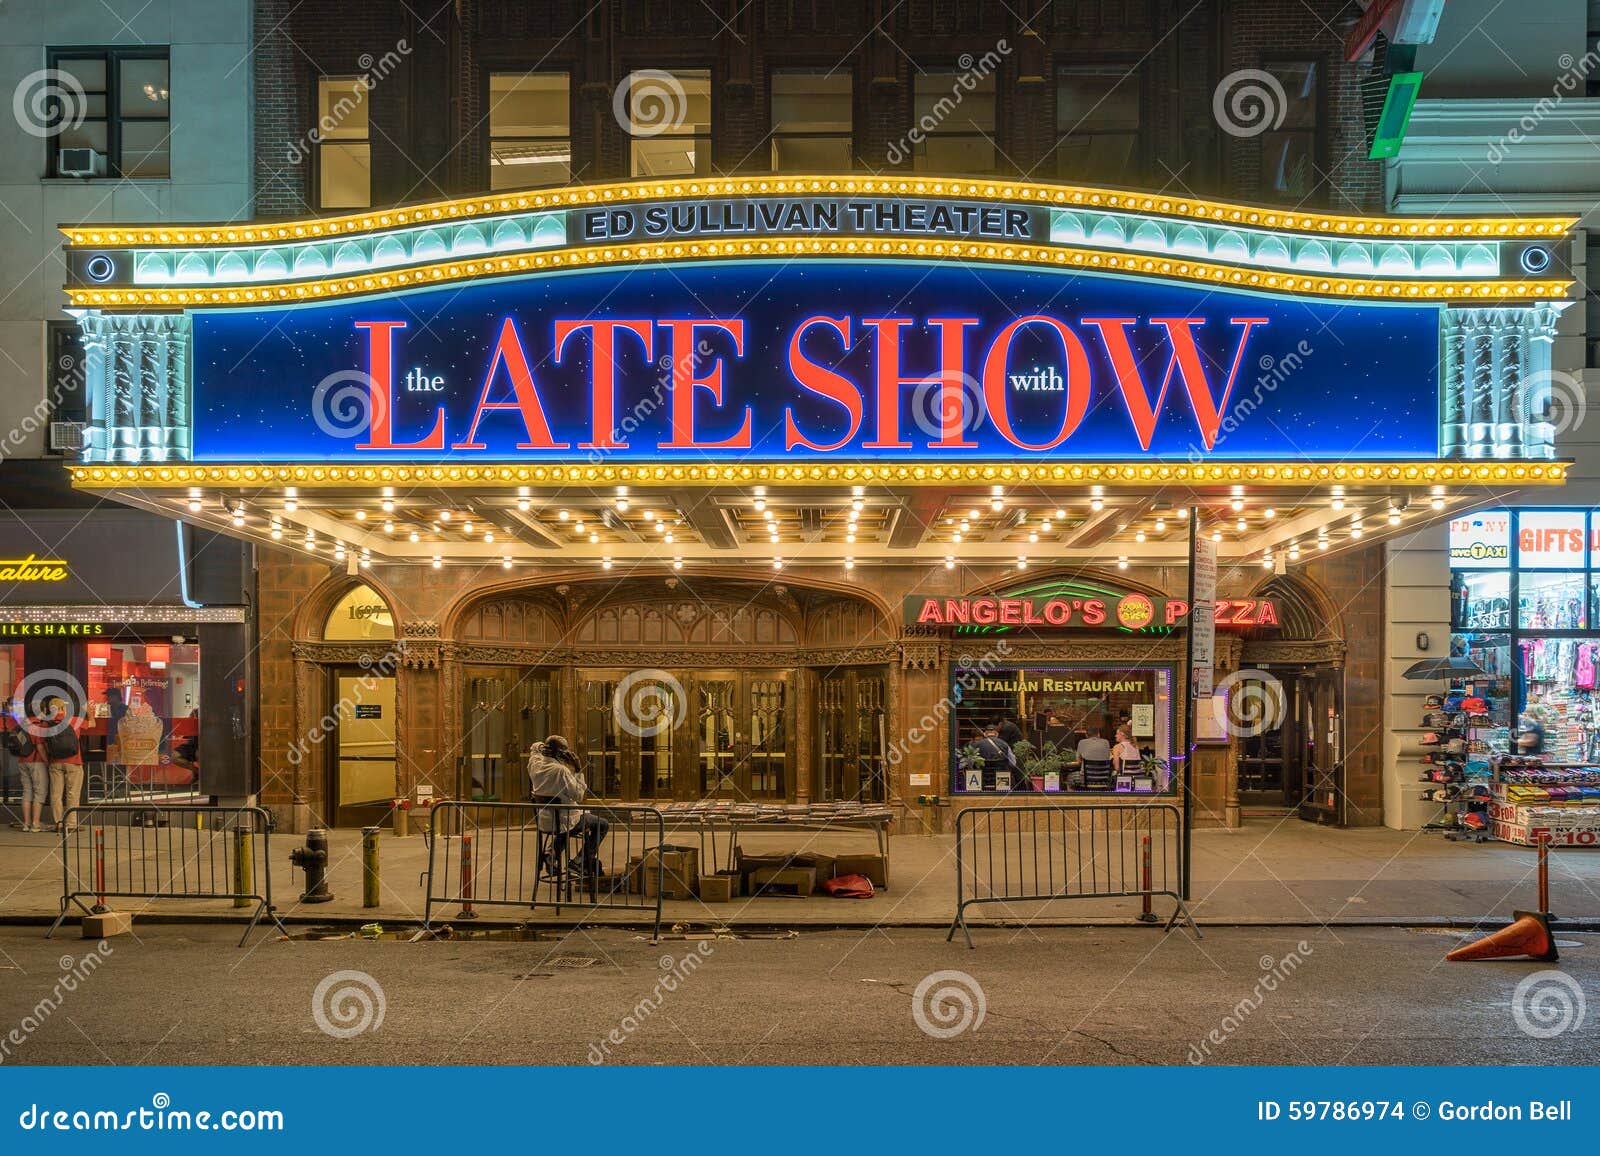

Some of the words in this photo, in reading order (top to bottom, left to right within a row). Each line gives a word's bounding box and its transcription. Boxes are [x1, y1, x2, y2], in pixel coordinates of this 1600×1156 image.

[584, 209, 635, 240] ED
[644, 203, 838, 236] SULLIVAN
[847, 203, 1031, 238] THEATER
[354, 317, 752, 450] LATE
[785, 314, 1270, 451] SHOW
[405, 367, 445, 393] the
[1009, 365, 1065, 392] with
[1519, 528, 1584, 552] GIFTS
[917, 599, 1107, 625] ANGELO'S
[1165, 600, 1279, 625] PZZA
[980, 678, 1038, 692] ITALIAN
[1043, 678, 1145, 692] RESTAURANT
[968, 773, 980, 787] A
[1501, 805, 1515, 820] FOR
